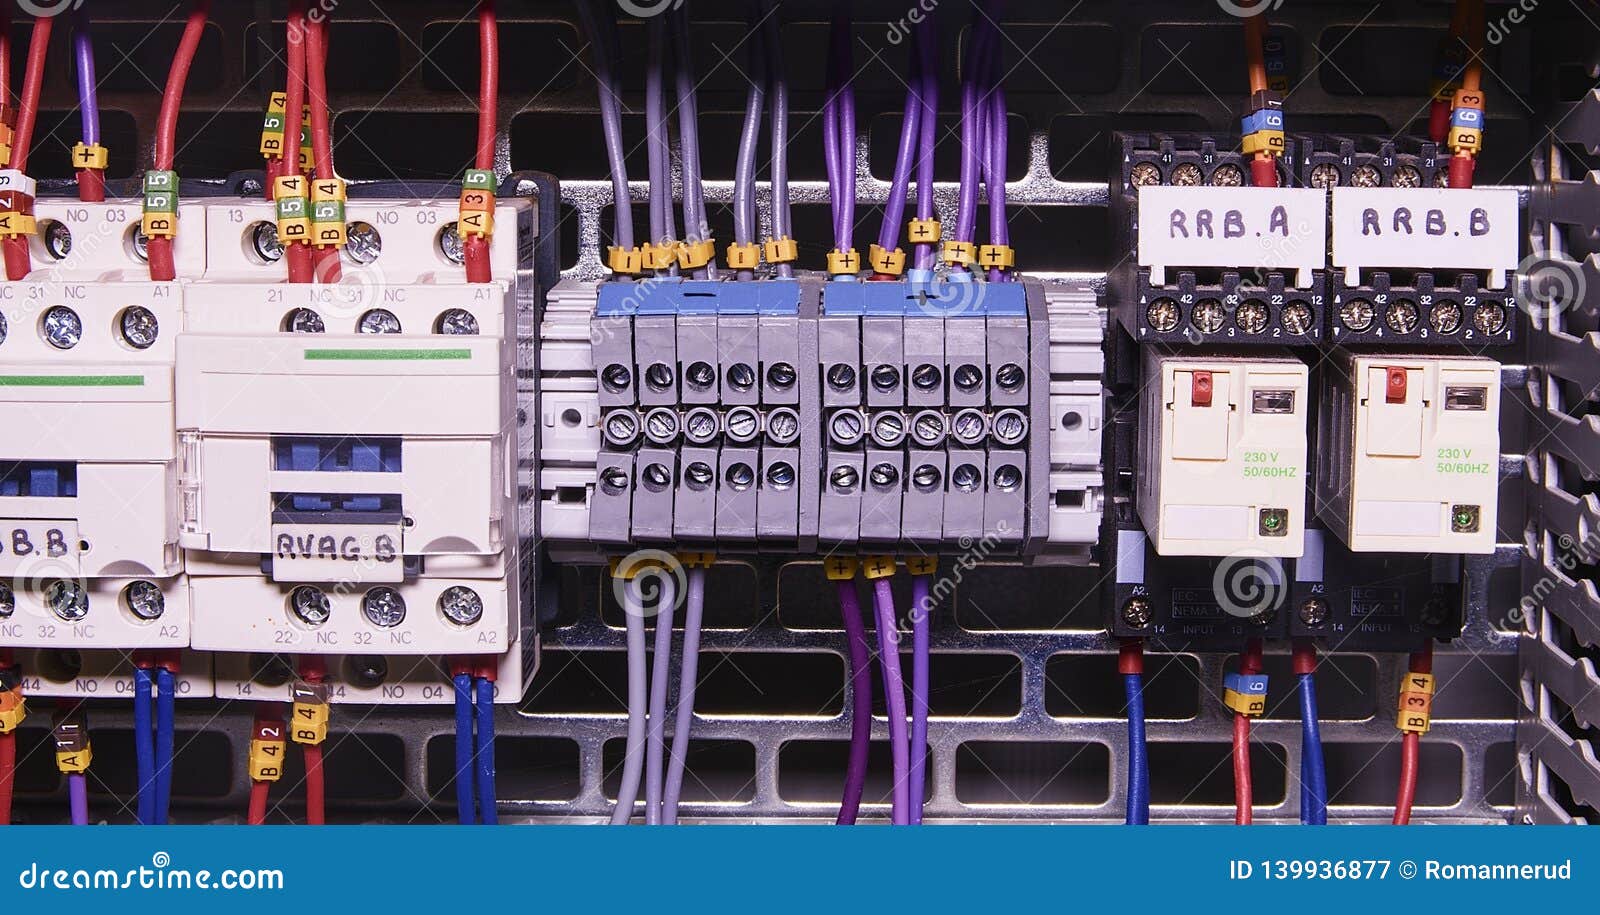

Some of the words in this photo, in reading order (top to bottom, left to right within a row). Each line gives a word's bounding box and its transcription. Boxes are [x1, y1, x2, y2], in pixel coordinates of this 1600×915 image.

[1162, 154, 1172, 163] 41
[1204, 154, 1213, 163] 31
[1342, 156, 1352, 166] 41
[1383, 156, 1393, 167] 31
[1425, 158, 1435, 168] 21
[66, 209, 89, 222] NO
[106, 209, 126, 222] 03
[229, 210, 244, 222] 13
[376, 211, 399, 223] NO
[416, 211, 437, 224] 03
[29, 287, 44, 299] 31
[64, 285, 86, 299] NC
[153, 285, 170, 297] A1
[267, 289, 282, 302] 21
[310, 289, 331, 302] NC
[384, 288, 406, 302] NC
[474, 288, 491, 300] A1
[1180, 294, 1193, 304] 42
[1226, 295, 1238, 305] 32
[1271, 295, 1283, 305] 22
[1312, 295, 1323, 306] 12
[1374, 294, 1387, 304] 42
[1420, 295, 1432, 305] 32
[1464, 296, 1477, 306] 22
[1504, 297, 1515, 307] 12
[1182, 328, 1190, 337] 4
[1228, 328, 1235, 337] 3
[1273, 328, 1280, 338] 2
[1375, 328, 1383, 337] 4
[1420, 328, 1428, 338] 3
[1465, 330, 1473, 339] 2
[1244, 452, 1267, 463] 230
[1269, 452, 1279, 462] V
[1437, 448, 1460, 459] 230
[1462, 448, 1472, 459] V
[1243, 467, 1297, 478] 50/60HZ
[1436, 463, 1489, 474] 50/60HZ
[2, 625, 23, 638] NC
[38, 625, 56, 638] 32
[73, 625, 95, 638] NC
[159, 625, 179, 638] A2
[1153, 625, 1165, 633] 14
[1332, 624, 1344, 632] 14
[274, 631, 293, 644] 22
[317, 631, 338, 645] NC
[353, 631, 372, 645] 32
[391, 631, 412, 645] NC
[478, 631, 497, 644] A2
[76, 679, 98, 692] NO
[236, 683, 252, 695] 14
[383, 686, 404, 699] NO
[422, 686, 443, 699] 04
